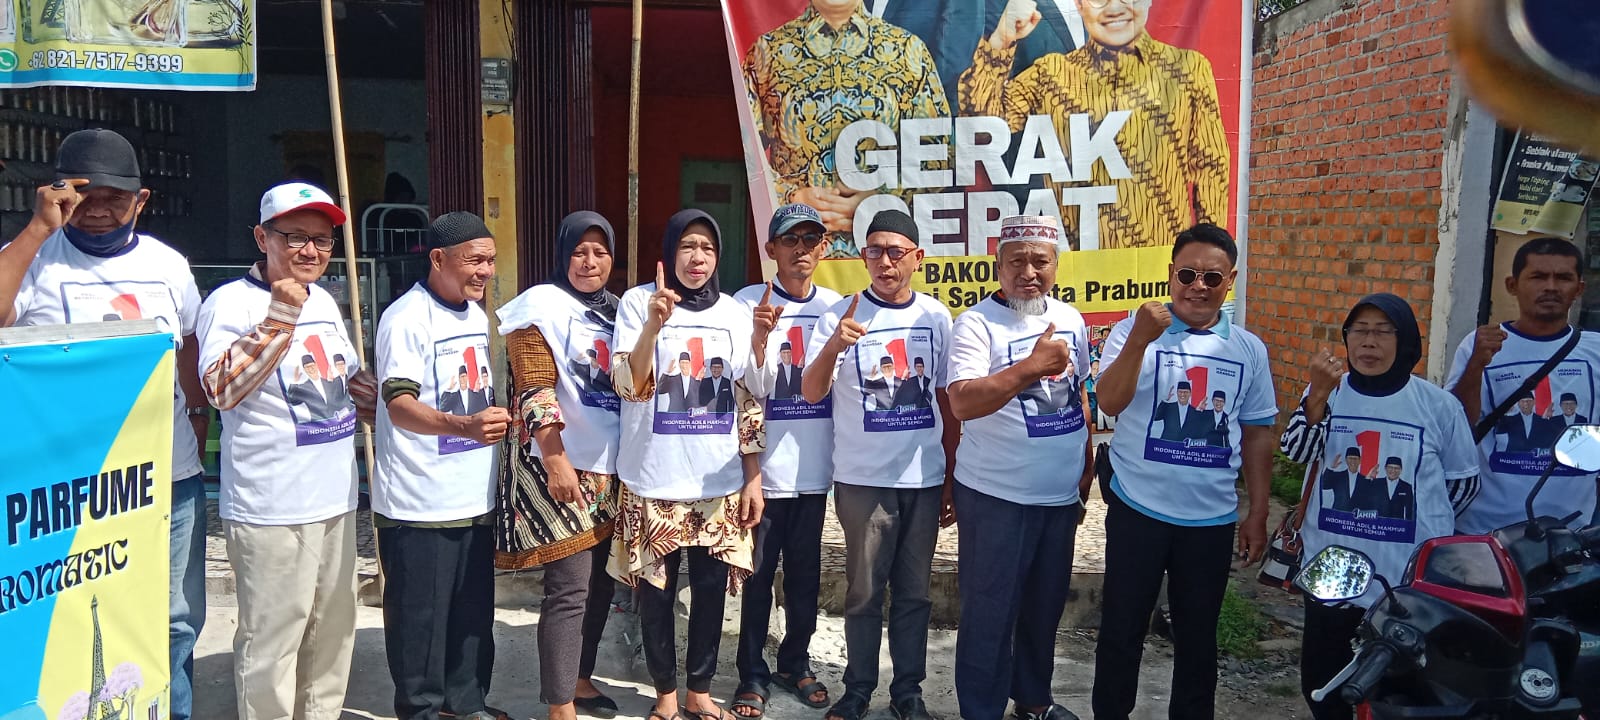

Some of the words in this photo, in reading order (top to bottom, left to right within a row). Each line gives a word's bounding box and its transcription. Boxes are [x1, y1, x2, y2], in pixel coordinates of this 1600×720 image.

[28, 51, 44, 69] +62
[47, 50, 183, 72] 821-7517-9399
[835, 110, 1133, 191] GERAK
[949, 286, 995, 308] Sak
[1085, 278, 1171, 303] Prabum
[686, 336, 705, 378] 1
[885, 338, 910, 380] 1
[1185, 366, 1208, 409] 1
[1153, 446, 1186, 455] INDONESIA
[1355, 430, 1381, 479] 1
[6, 461, 154, 546] PARFUME
[1325, 516, 1356, 527] INDONESIA
[1356, 521, 1370, 529] ADIL
[1377, 525, 1406, 533] MAKMUR
[1342, 525, 1363, 533] UNTUK
[1364, 528, 1386, 536] SEMUA
[0, 538, 128, 613] ROMATIC
